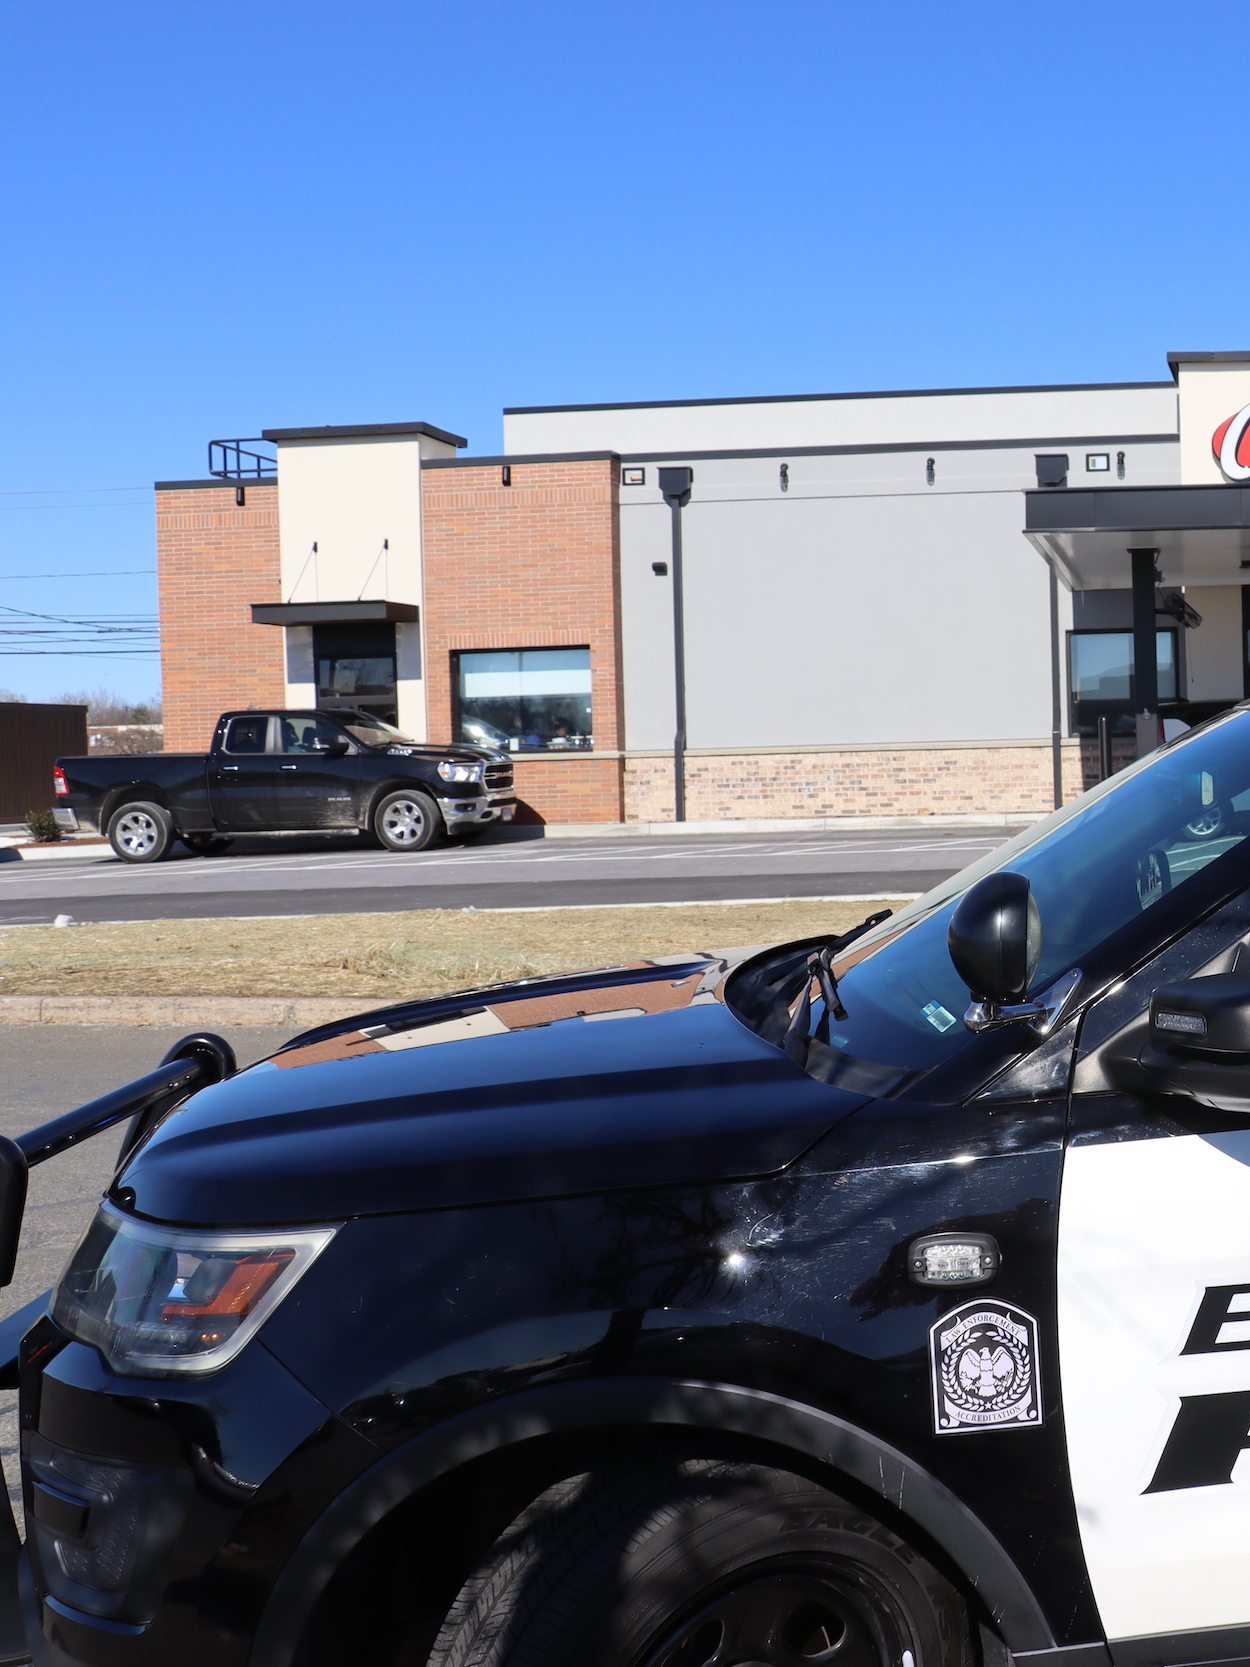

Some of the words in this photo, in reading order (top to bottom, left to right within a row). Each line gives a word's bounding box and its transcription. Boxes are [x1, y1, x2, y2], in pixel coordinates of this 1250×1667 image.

[945, 1328, 962, 1342] LAW
[963, 1314, 1022, 1337] ENFORCEMENT
[956, 1405, 1021, 1422] ACCREDITATION
